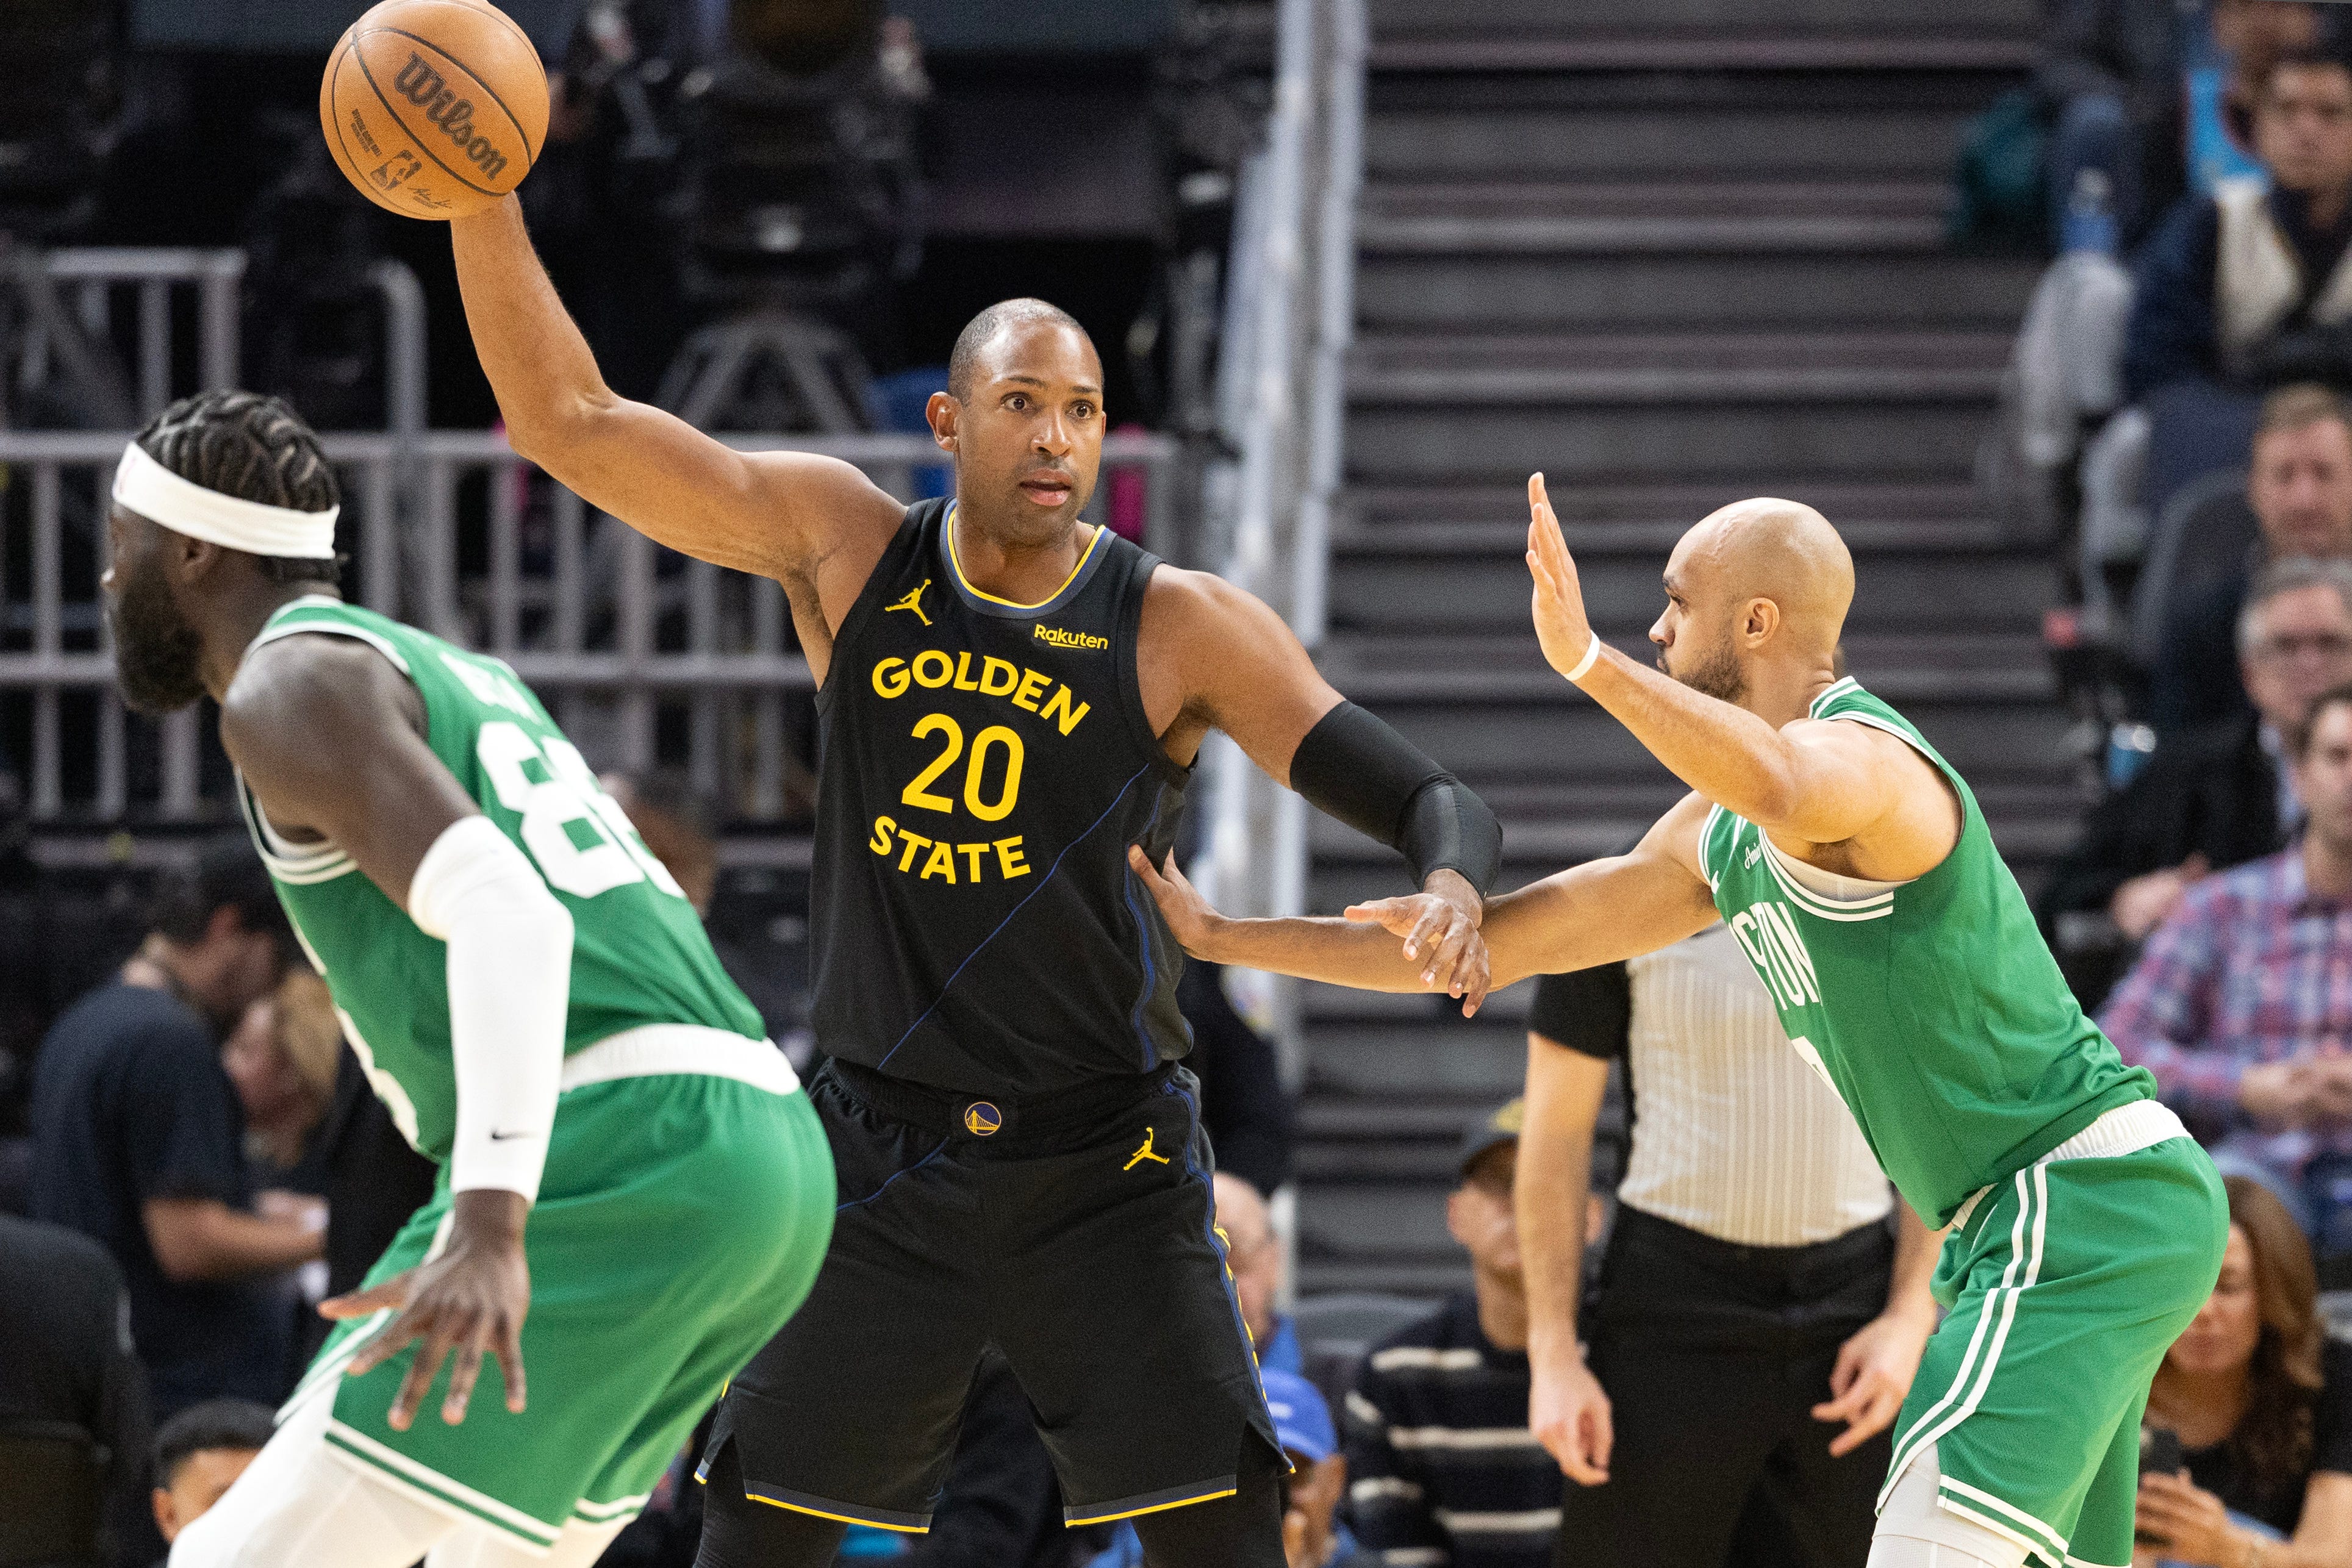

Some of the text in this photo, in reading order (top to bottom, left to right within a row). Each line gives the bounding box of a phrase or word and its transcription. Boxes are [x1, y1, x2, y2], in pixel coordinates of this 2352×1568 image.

[394, 51, 508, 181] Wilson
[1034, 623, 1108, 650] Rakuten
[872, 650, 1091, 737] GOLDEN
[901, 712, 1025, 822] 20
[869, 815, 1031, 885] STATE
